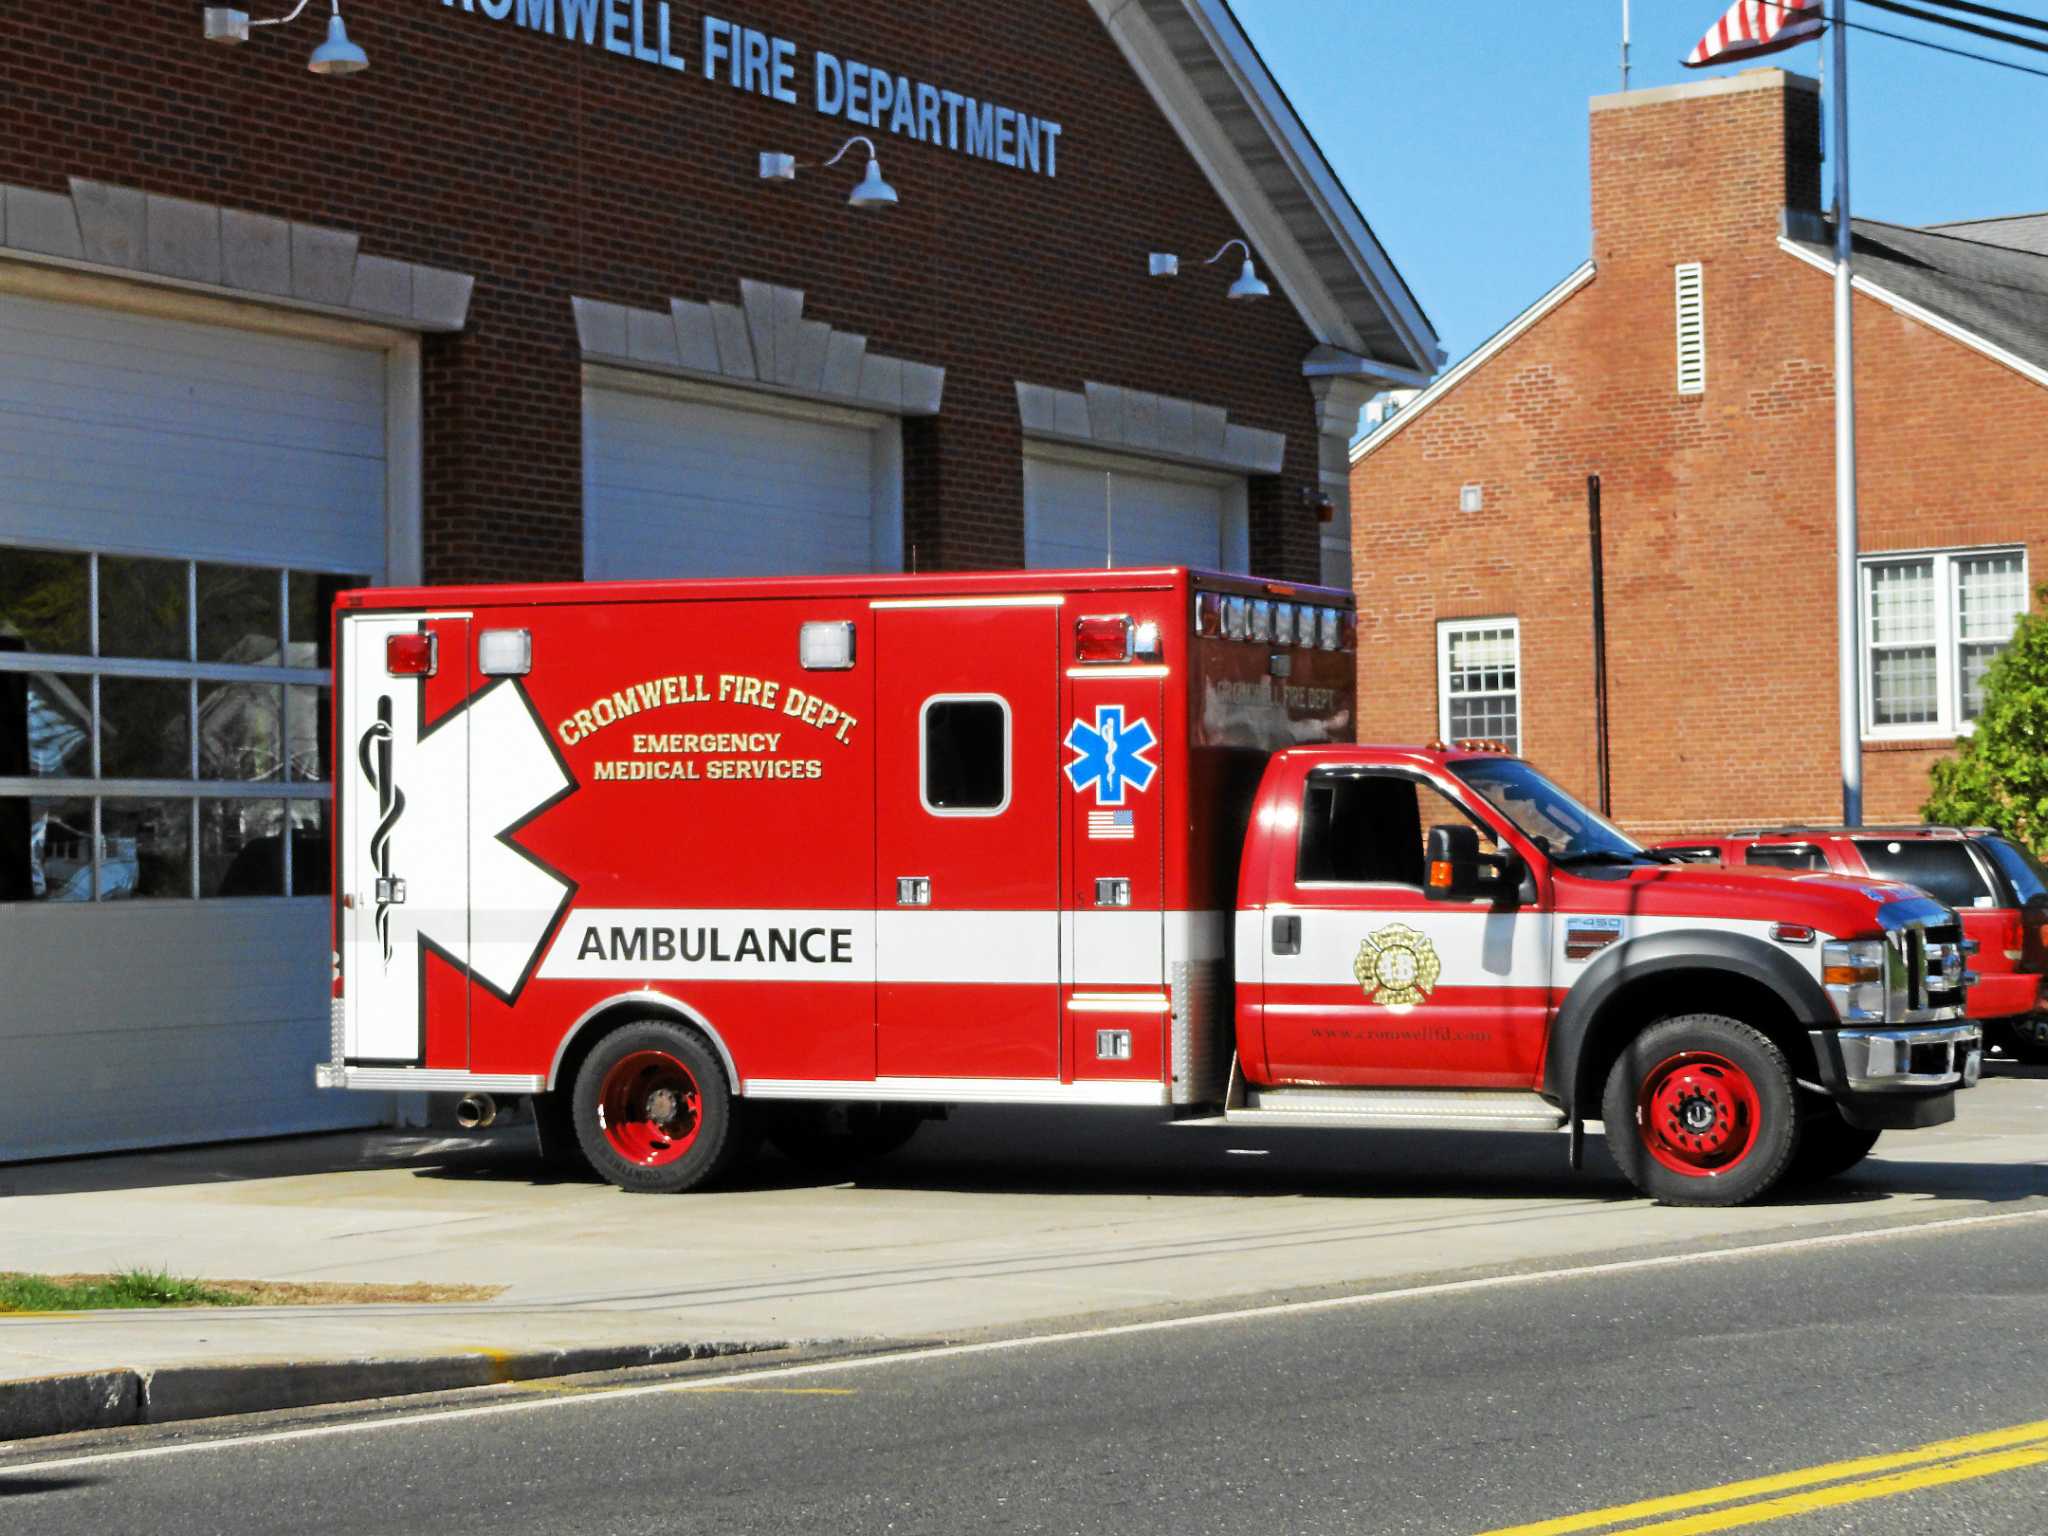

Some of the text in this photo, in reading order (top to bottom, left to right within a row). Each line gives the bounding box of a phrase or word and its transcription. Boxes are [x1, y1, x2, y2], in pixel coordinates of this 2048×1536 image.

[704, 16, 796, 103] FIRE
[815, 51, 1062, 178] DEPARTMENT
[558, 675, 857, 746] CROMWELL FIRE DEPT.
[633, 733, 781, 752] EMERGENCY
[593, 760, 823, 781] MEDICAL SERVICES
[577, 926, 853, 963] AMBULANCE
